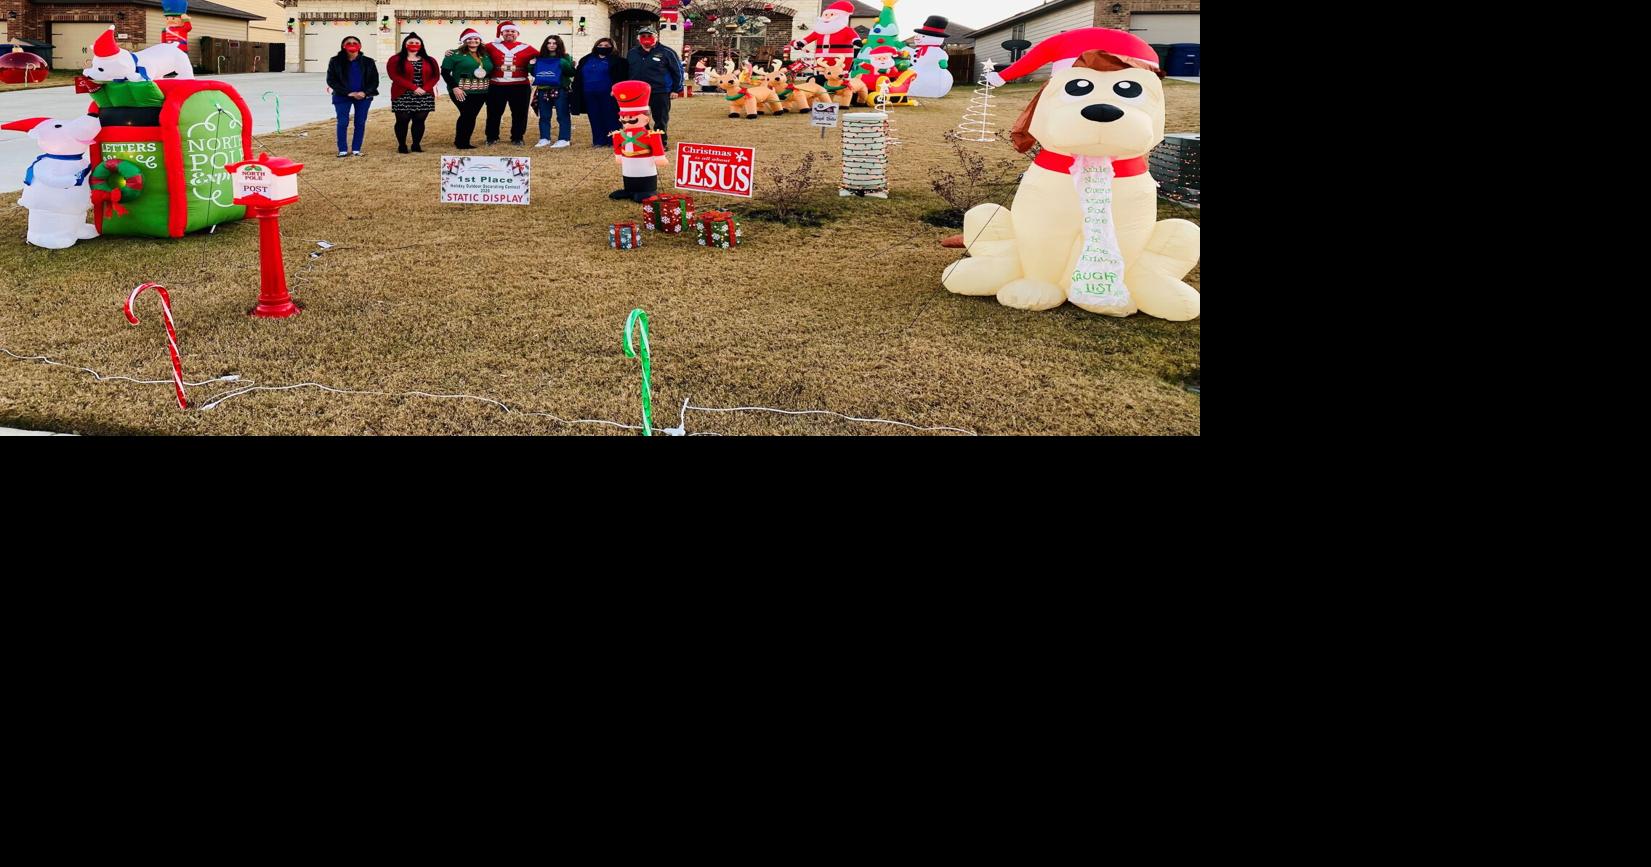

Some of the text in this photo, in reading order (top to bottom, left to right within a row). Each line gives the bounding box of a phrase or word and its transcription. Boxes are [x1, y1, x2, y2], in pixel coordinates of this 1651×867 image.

[101, 143, 156, 153] LETTERS
[683, 146, 732, 156] Christmas
[677, 154, 749, 191] JESUS
[243, 185, 268, 193] POST
[483, 194, 523, 202] DISPLAY
[1086, 282, 1112, 292] LIST
